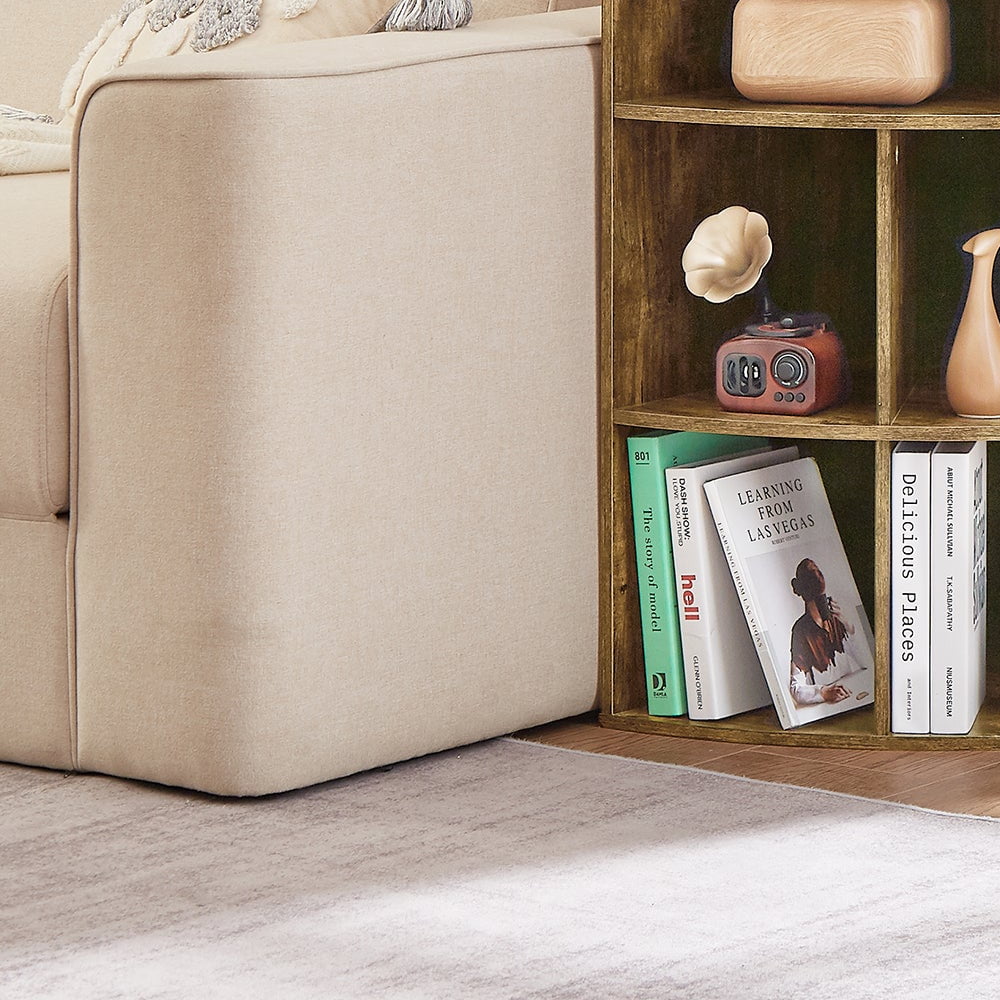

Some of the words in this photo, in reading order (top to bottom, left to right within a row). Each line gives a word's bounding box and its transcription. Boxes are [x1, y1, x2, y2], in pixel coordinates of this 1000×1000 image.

[634, 451, 651, 461] 801
[679, 478, 688, 505] DASH
[737, 478, 803, 505] LEARNING
[642, 507, 653, 533] The
[758, 500, 794, 520] FROM
[902, 474, 918, 579] Delicious
[644, 537, 654, 570] story
[647, 574, 658, 588] of
[681, 574, 700, 621] hell
[649, 592, 662, 632] model
[902, 592, 918, 662] Places
